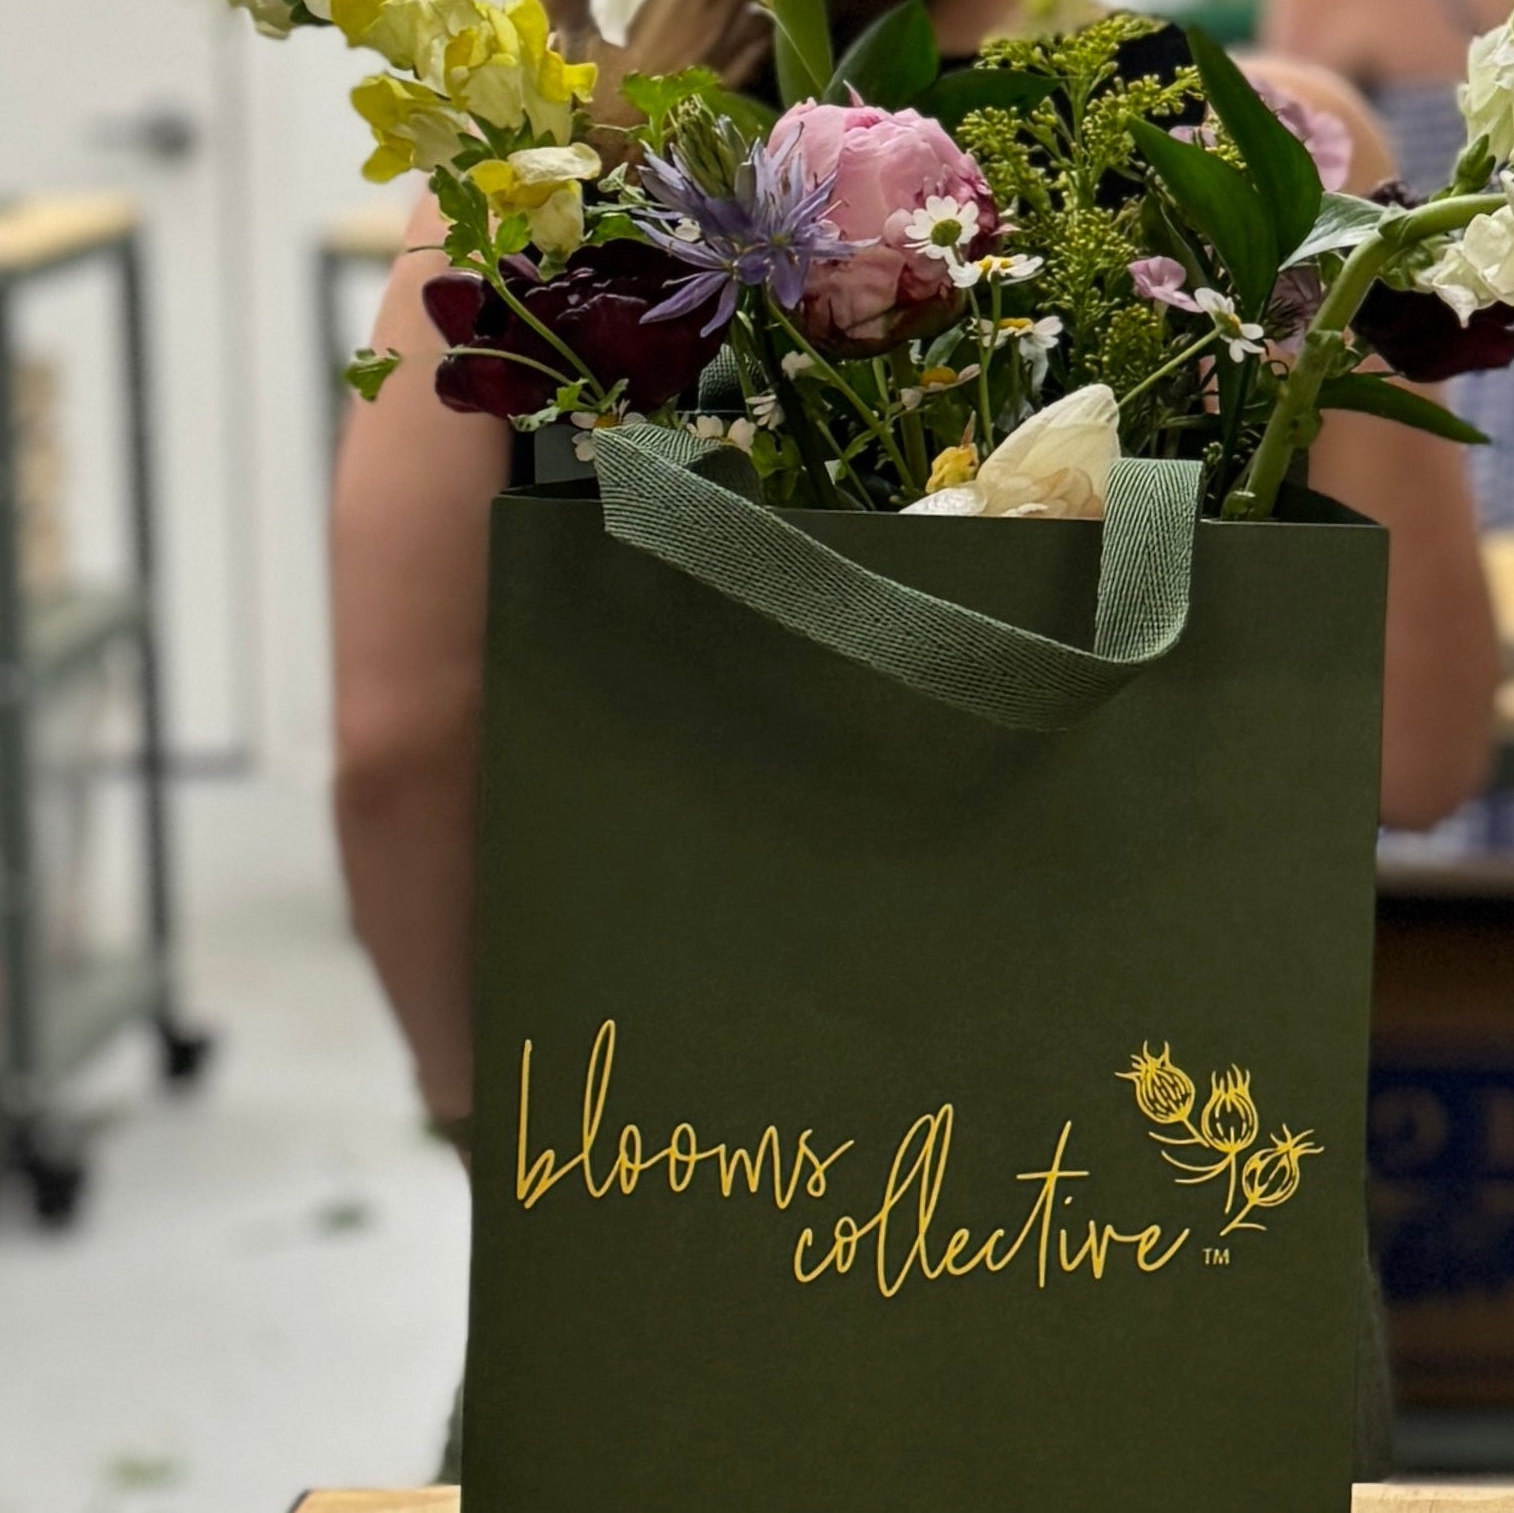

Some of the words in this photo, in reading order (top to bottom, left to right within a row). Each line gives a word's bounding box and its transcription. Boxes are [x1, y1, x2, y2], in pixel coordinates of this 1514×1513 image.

[516, 1019, 854, 1209] blooms
[793, 1103, 1190, 1298] collective
[1202, 1247, 1230, 1265] TM
